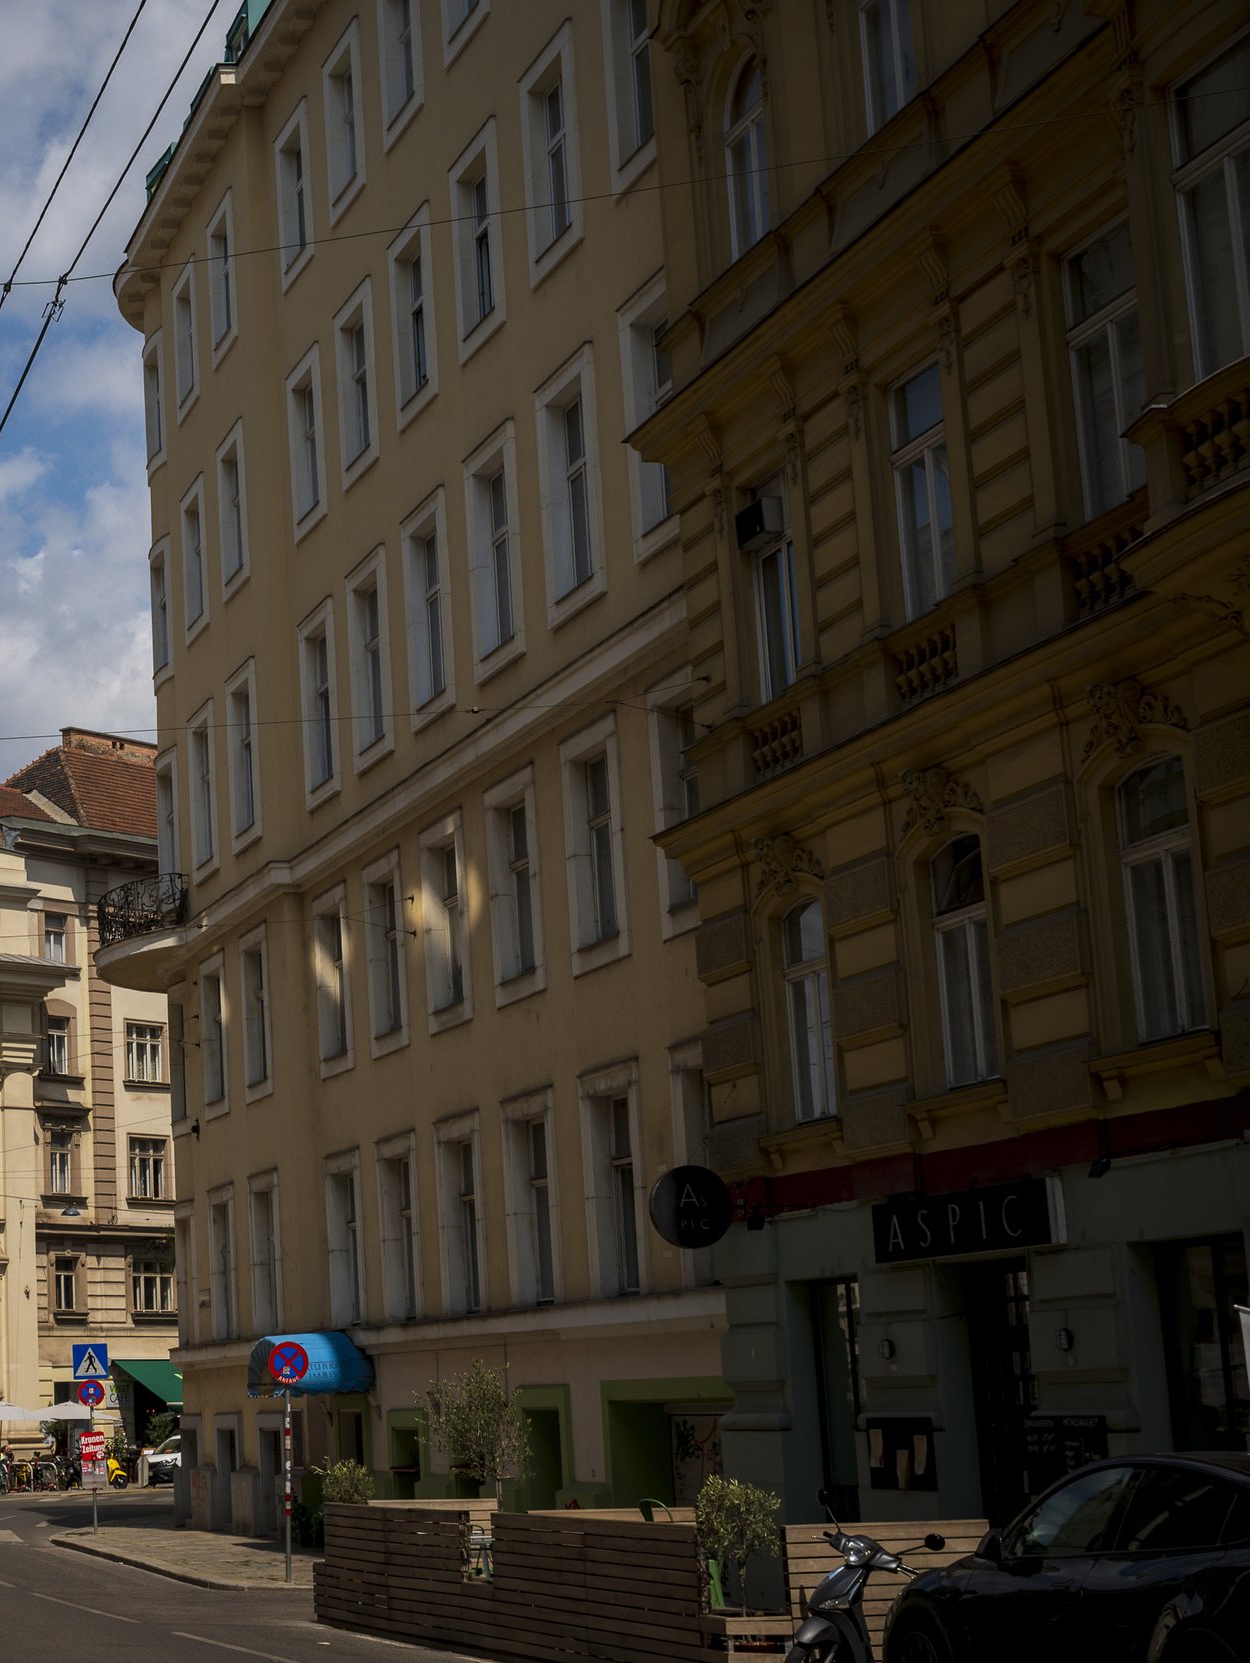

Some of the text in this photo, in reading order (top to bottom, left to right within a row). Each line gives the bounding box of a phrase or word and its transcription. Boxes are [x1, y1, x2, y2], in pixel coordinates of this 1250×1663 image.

[888, 1195, 1023, 1253] ASPIC
[277, 1375, 301, 1384] ANFANG
[80, 1435, 104, 1445] Kronen
[81, 1444, 106, 1454] Zeitung
